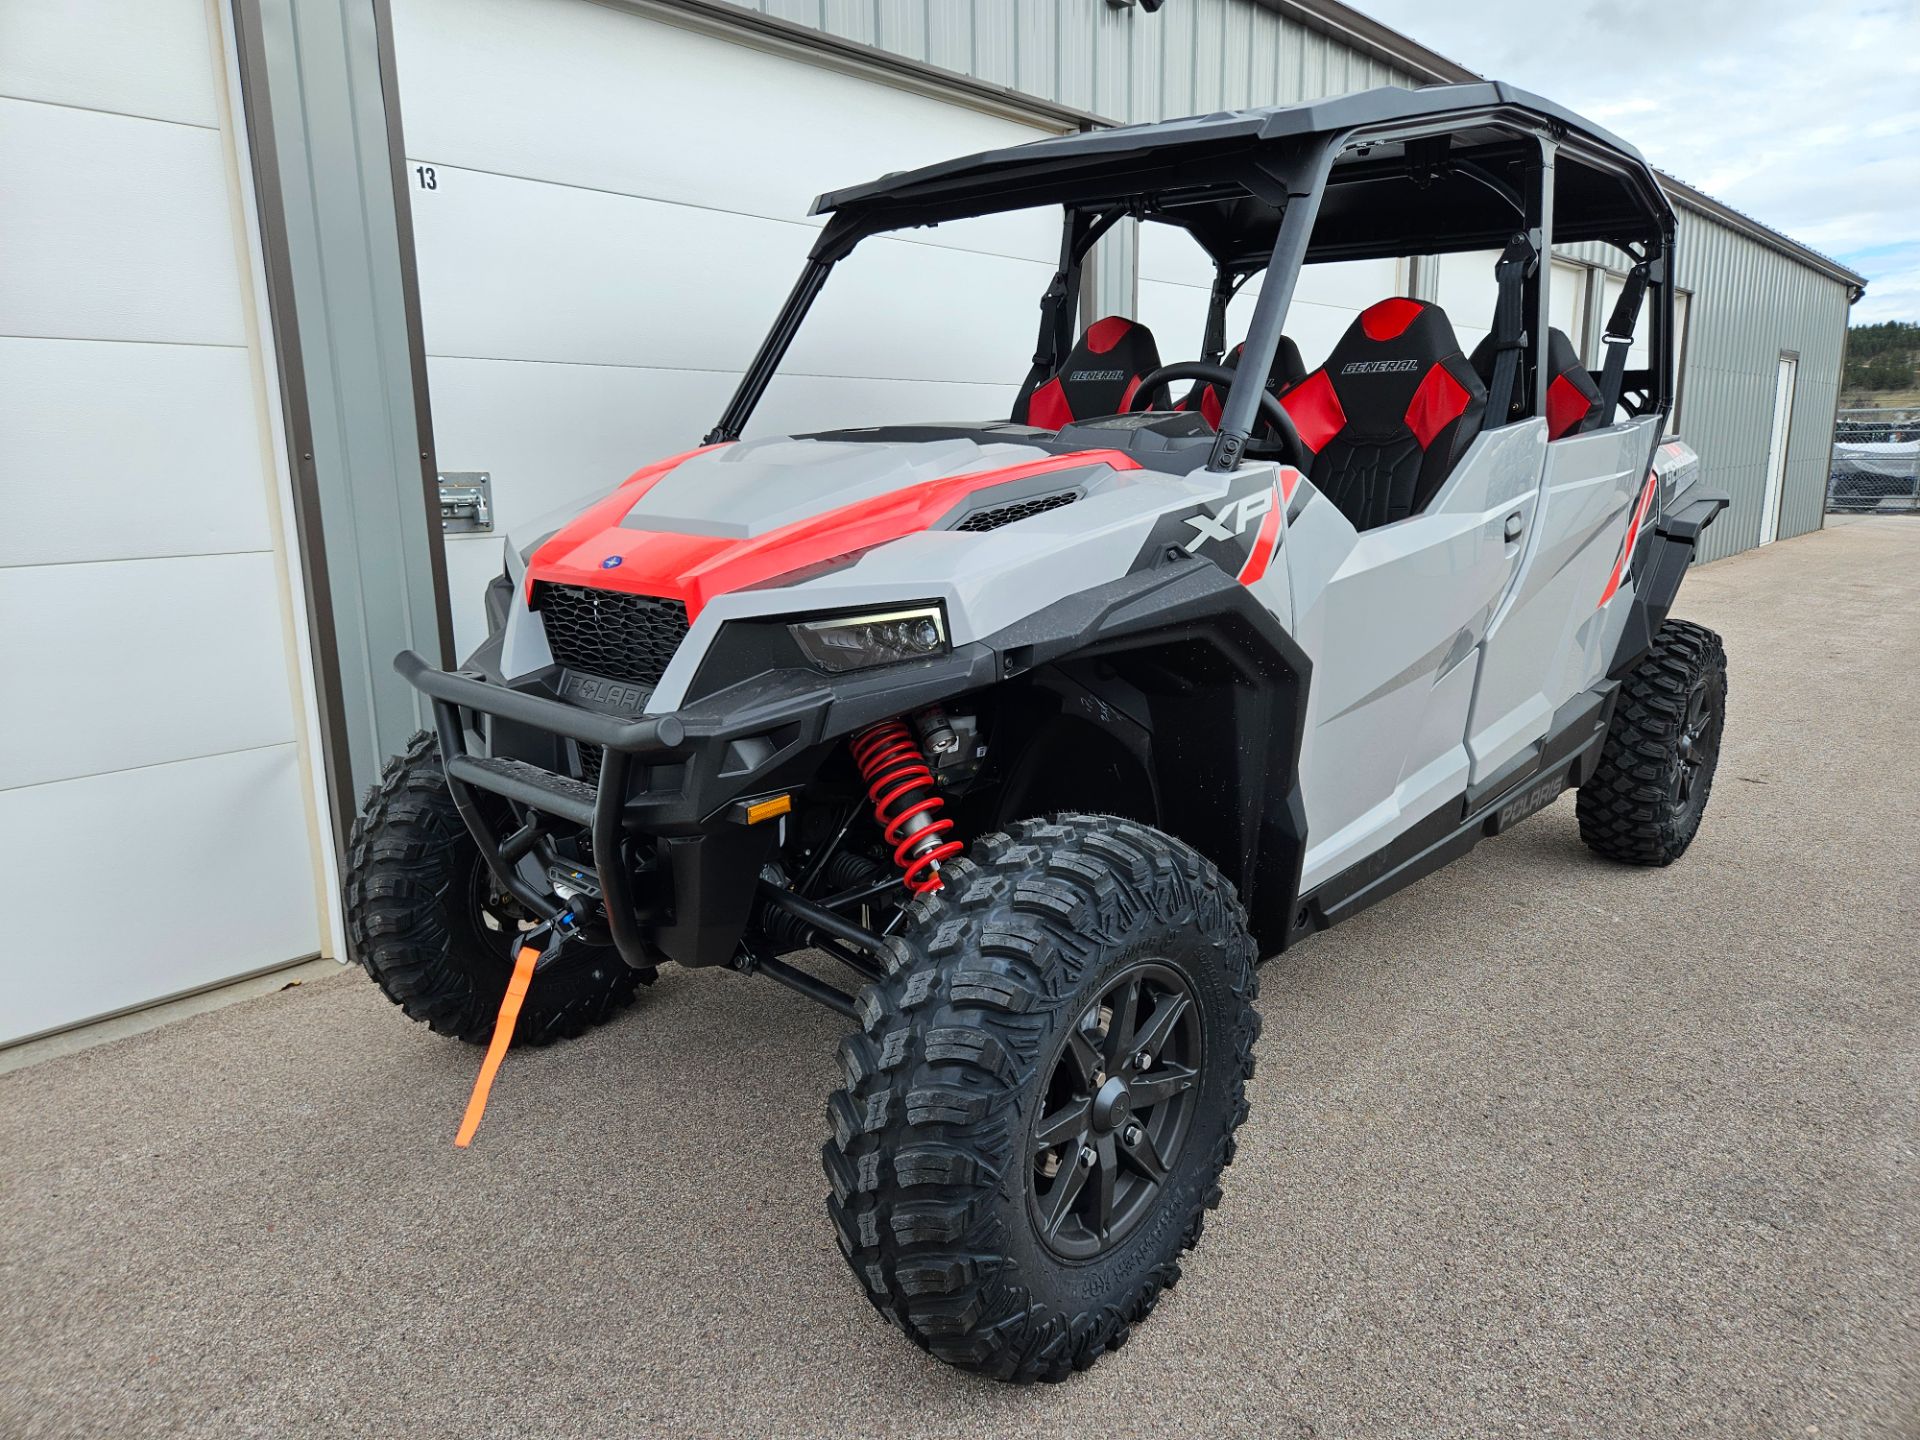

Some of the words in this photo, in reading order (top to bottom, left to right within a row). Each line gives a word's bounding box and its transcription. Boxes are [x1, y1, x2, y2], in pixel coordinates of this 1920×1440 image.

[416, 165, 437, 190] 13
[1070, 369, 1124, 381] GENERAL
[1341, 359, 1418, 375] GENERAL
[1183, 486, 1274, 553] XP
[1500, 775, 1564, 829] POLARIS
